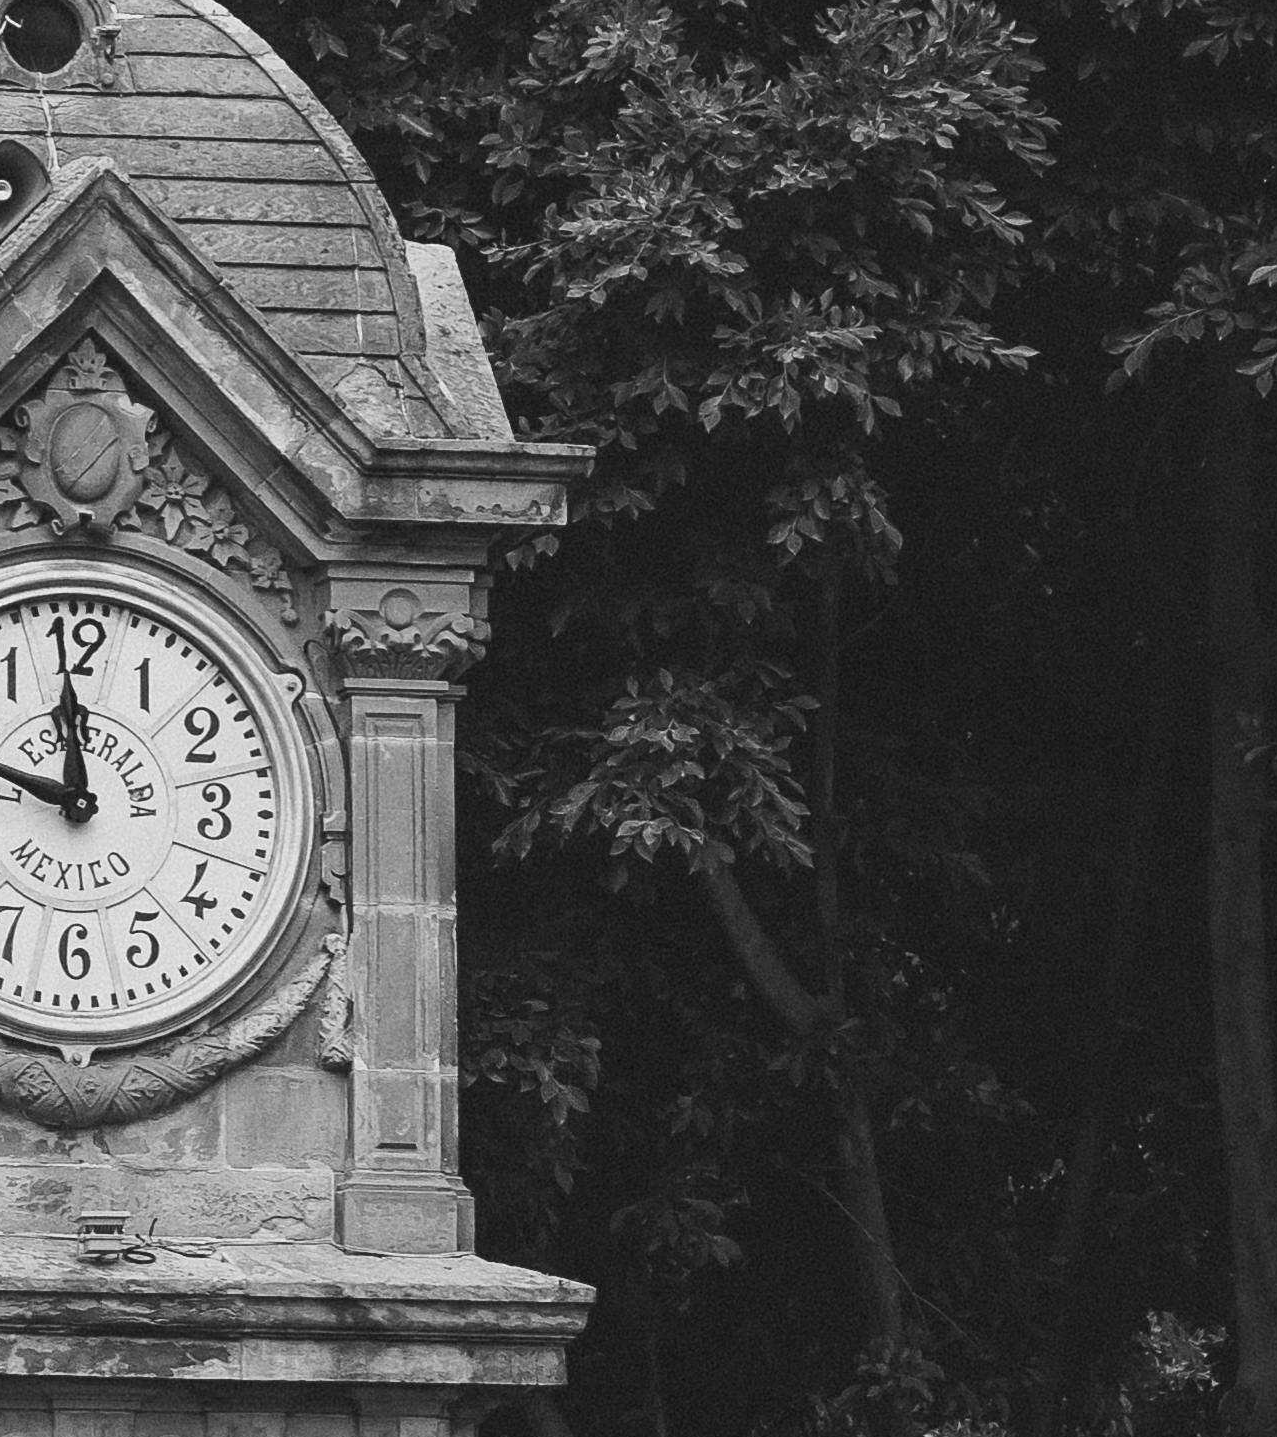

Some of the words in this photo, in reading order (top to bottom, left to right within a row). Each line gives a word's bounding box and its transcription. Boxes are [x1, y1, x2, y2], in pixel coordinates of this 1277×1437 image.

[45, 616, 107, 677] 12
[133, 656, 151, 713] 1
[184, 706, 220, 763] 2
[18, 722, 156, 819] ESERALDA
[197, 782, 232, 840] 3
[9, 838, 131, 892] MEXICO
[180, 856, 220, 919] 4
[59, 924, 90, 980] 6
[127, 912, 159, 968] 5
